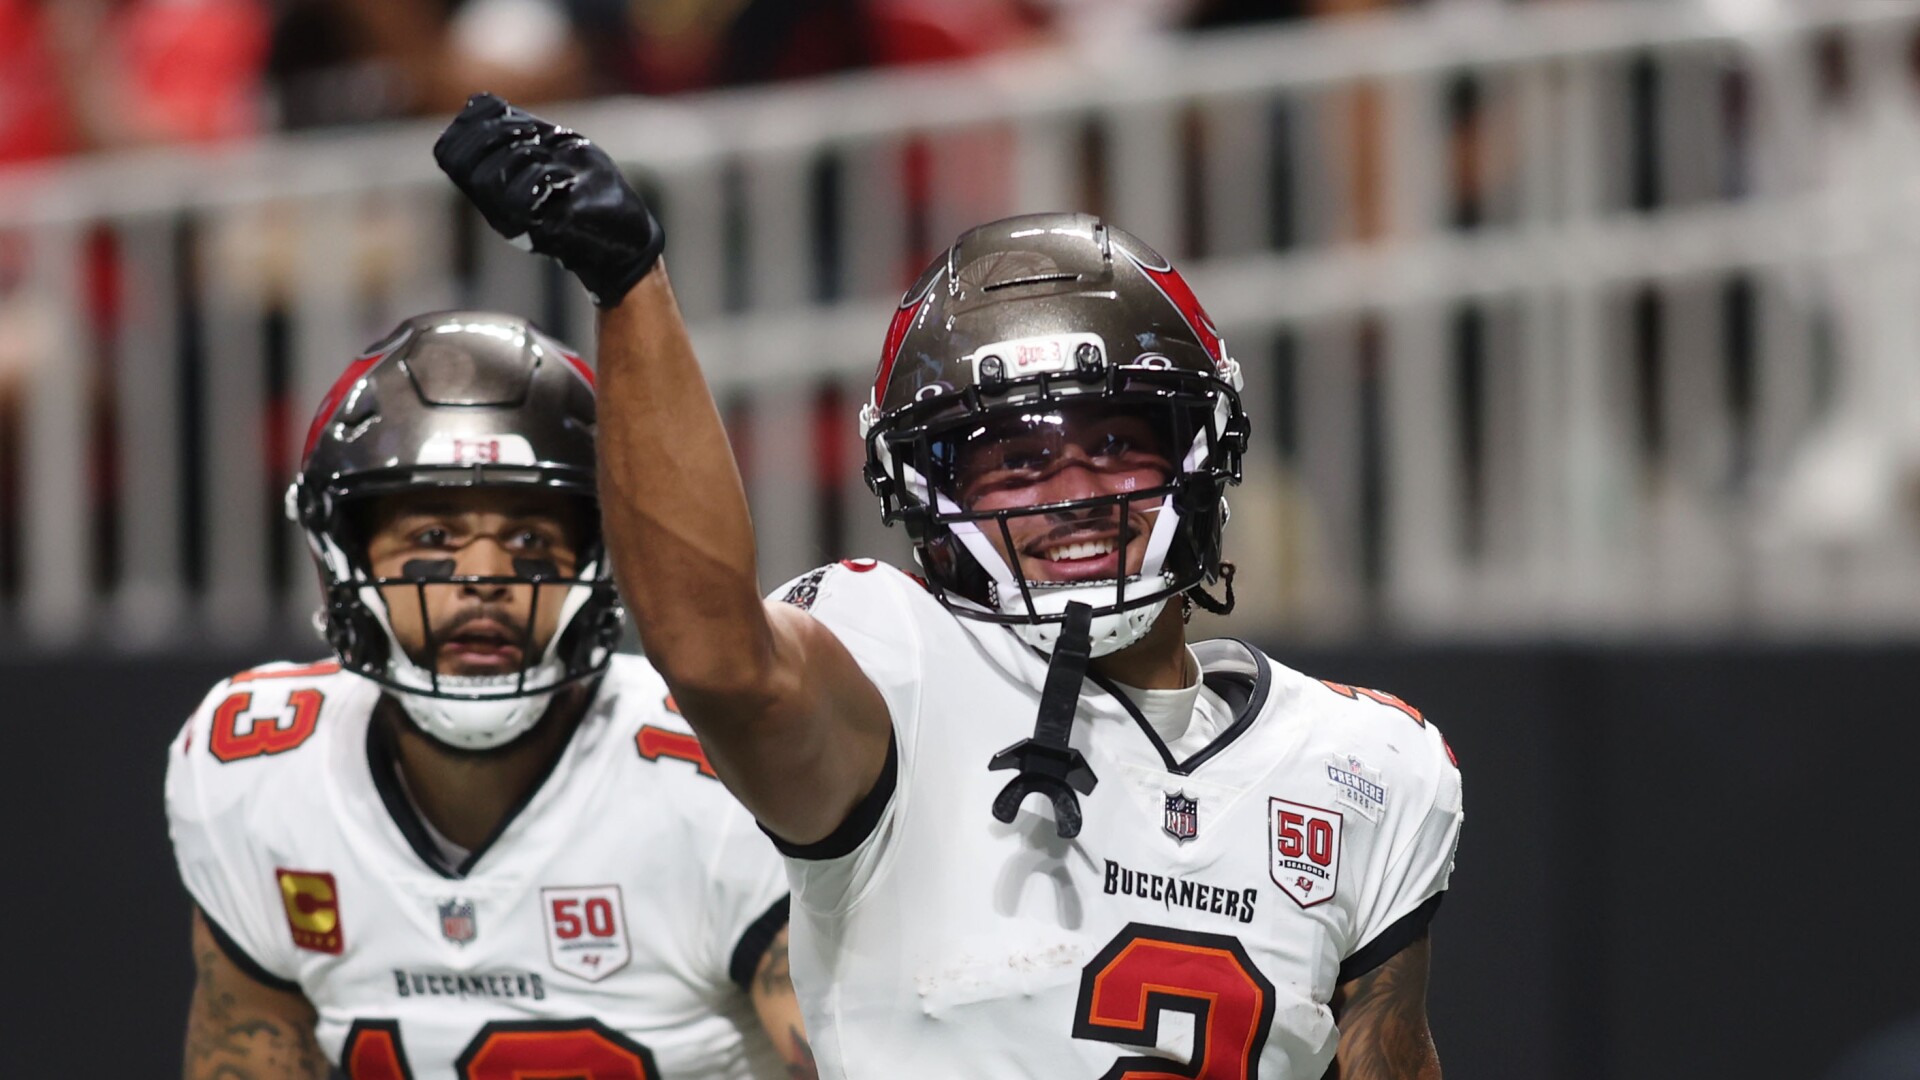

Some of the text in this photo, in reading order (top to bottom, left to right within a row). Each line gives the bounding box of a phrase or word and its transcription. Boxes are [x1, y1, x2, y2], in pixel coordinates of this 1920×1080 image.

[1277, 809, 1333, 867] 50
[1103, 858, 1257, 924] BUCCANEERS
[1285, 860, 1324, 879] SEASONS
[280, 874, 336, 934] C
[552, 897, 616, 940] 50
[1072, 921, 1276, 1080] 2
